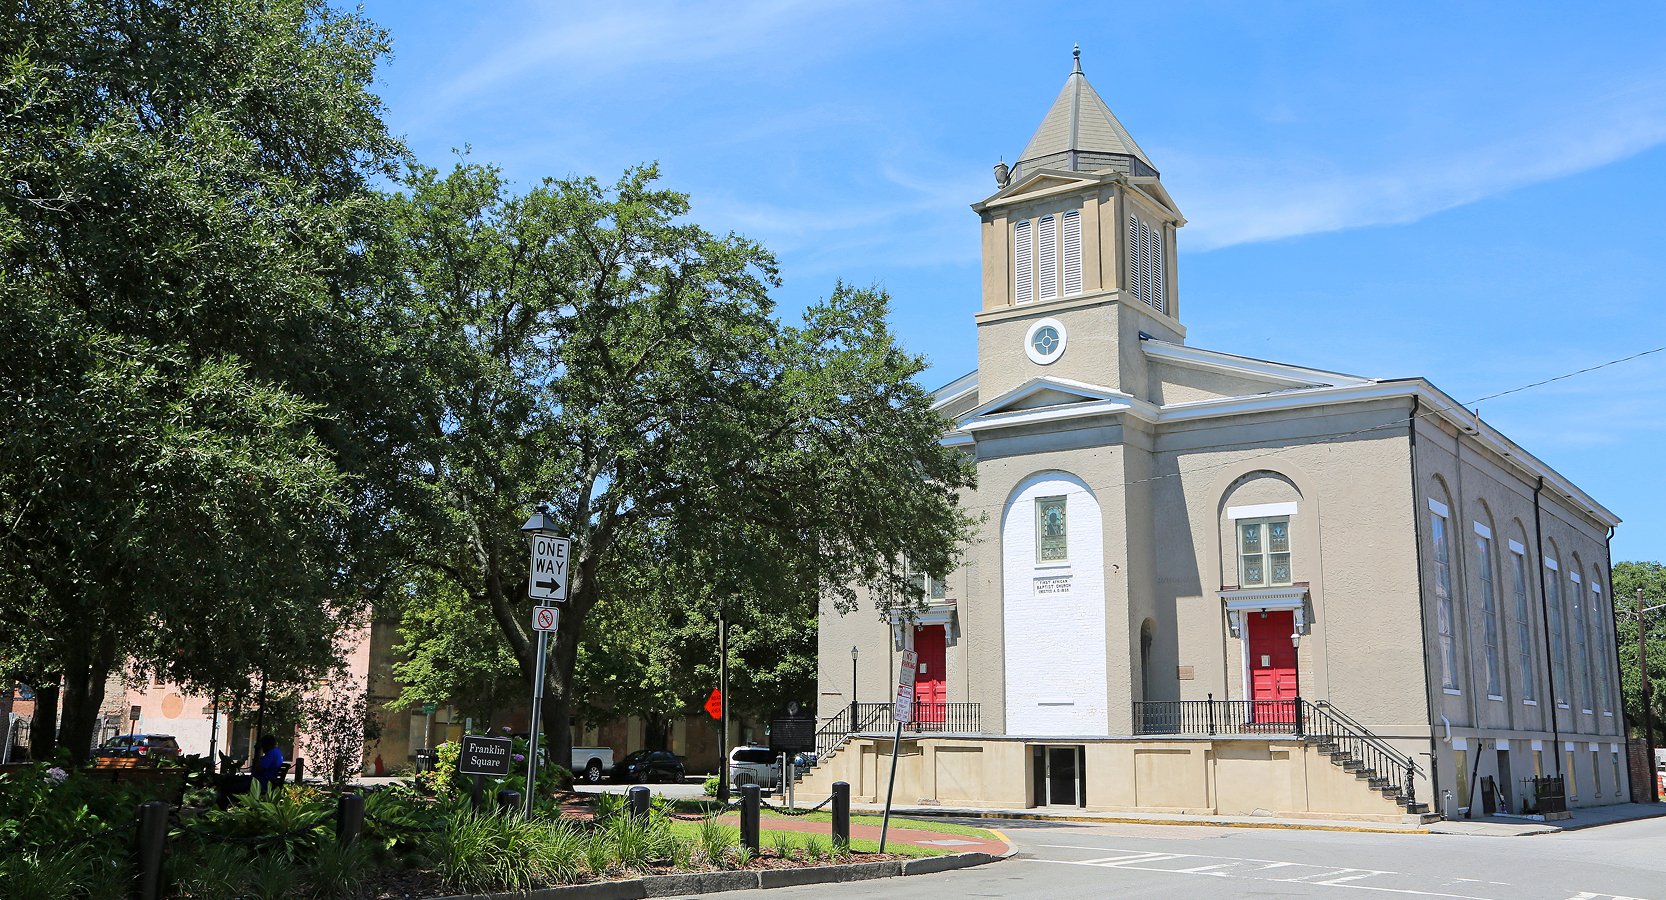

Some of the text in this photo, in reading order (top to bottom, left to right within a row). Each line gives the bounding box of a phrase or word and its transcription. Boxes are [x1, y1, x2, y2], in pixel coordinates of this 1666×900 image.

[537, 540, 565, 558] ONE
[536, 557, 565, 575] WAY
[906, 652, 913, 661] NO
[902, 660, 916, 669] PARKING
[469, 742, 506, 755] Franklin
[470, 755, 501, 768] Square
